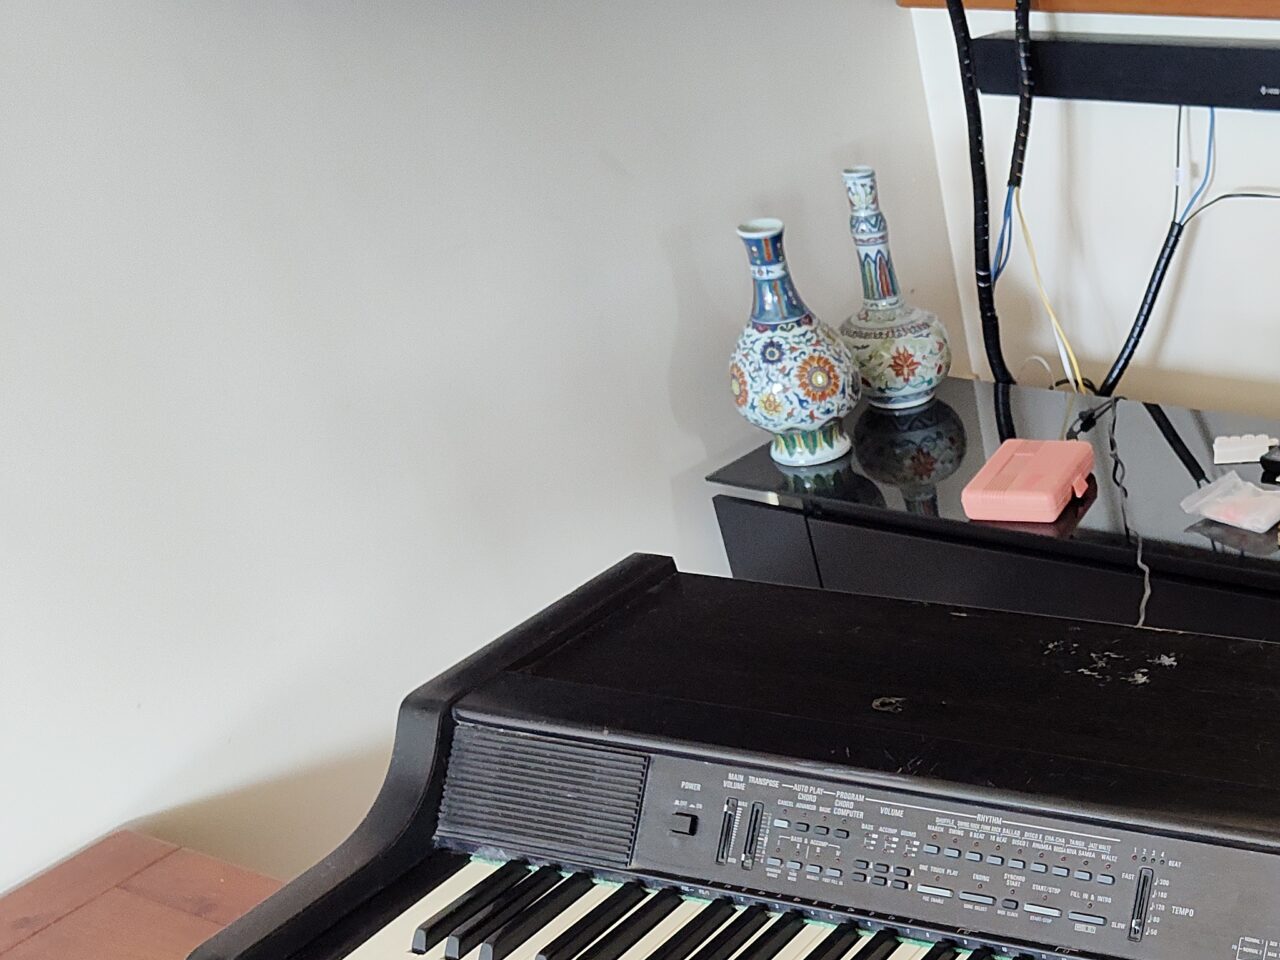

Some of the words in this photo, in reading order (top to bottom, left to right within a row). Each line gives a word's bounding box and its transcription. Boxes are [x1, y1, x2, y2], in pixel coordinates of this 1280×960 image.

[681, 781, 701, 791] POWER
[723, 780, 746, 790] VOLUME
[749, 776, 780, 788] TRANSPOSE
[809, 786, 824, 795] PLAY
[836, 791, 865, 801] PROGRAM
[833, 807, 864, 819] COMPUTER
[880, 807, 904, 818] VOLUME
[976, 814, 1002, 824] RHYTHM
[1032, 884, 1061, 894] START/STOP
[1172, 906, 1194, 917] TEMPO
